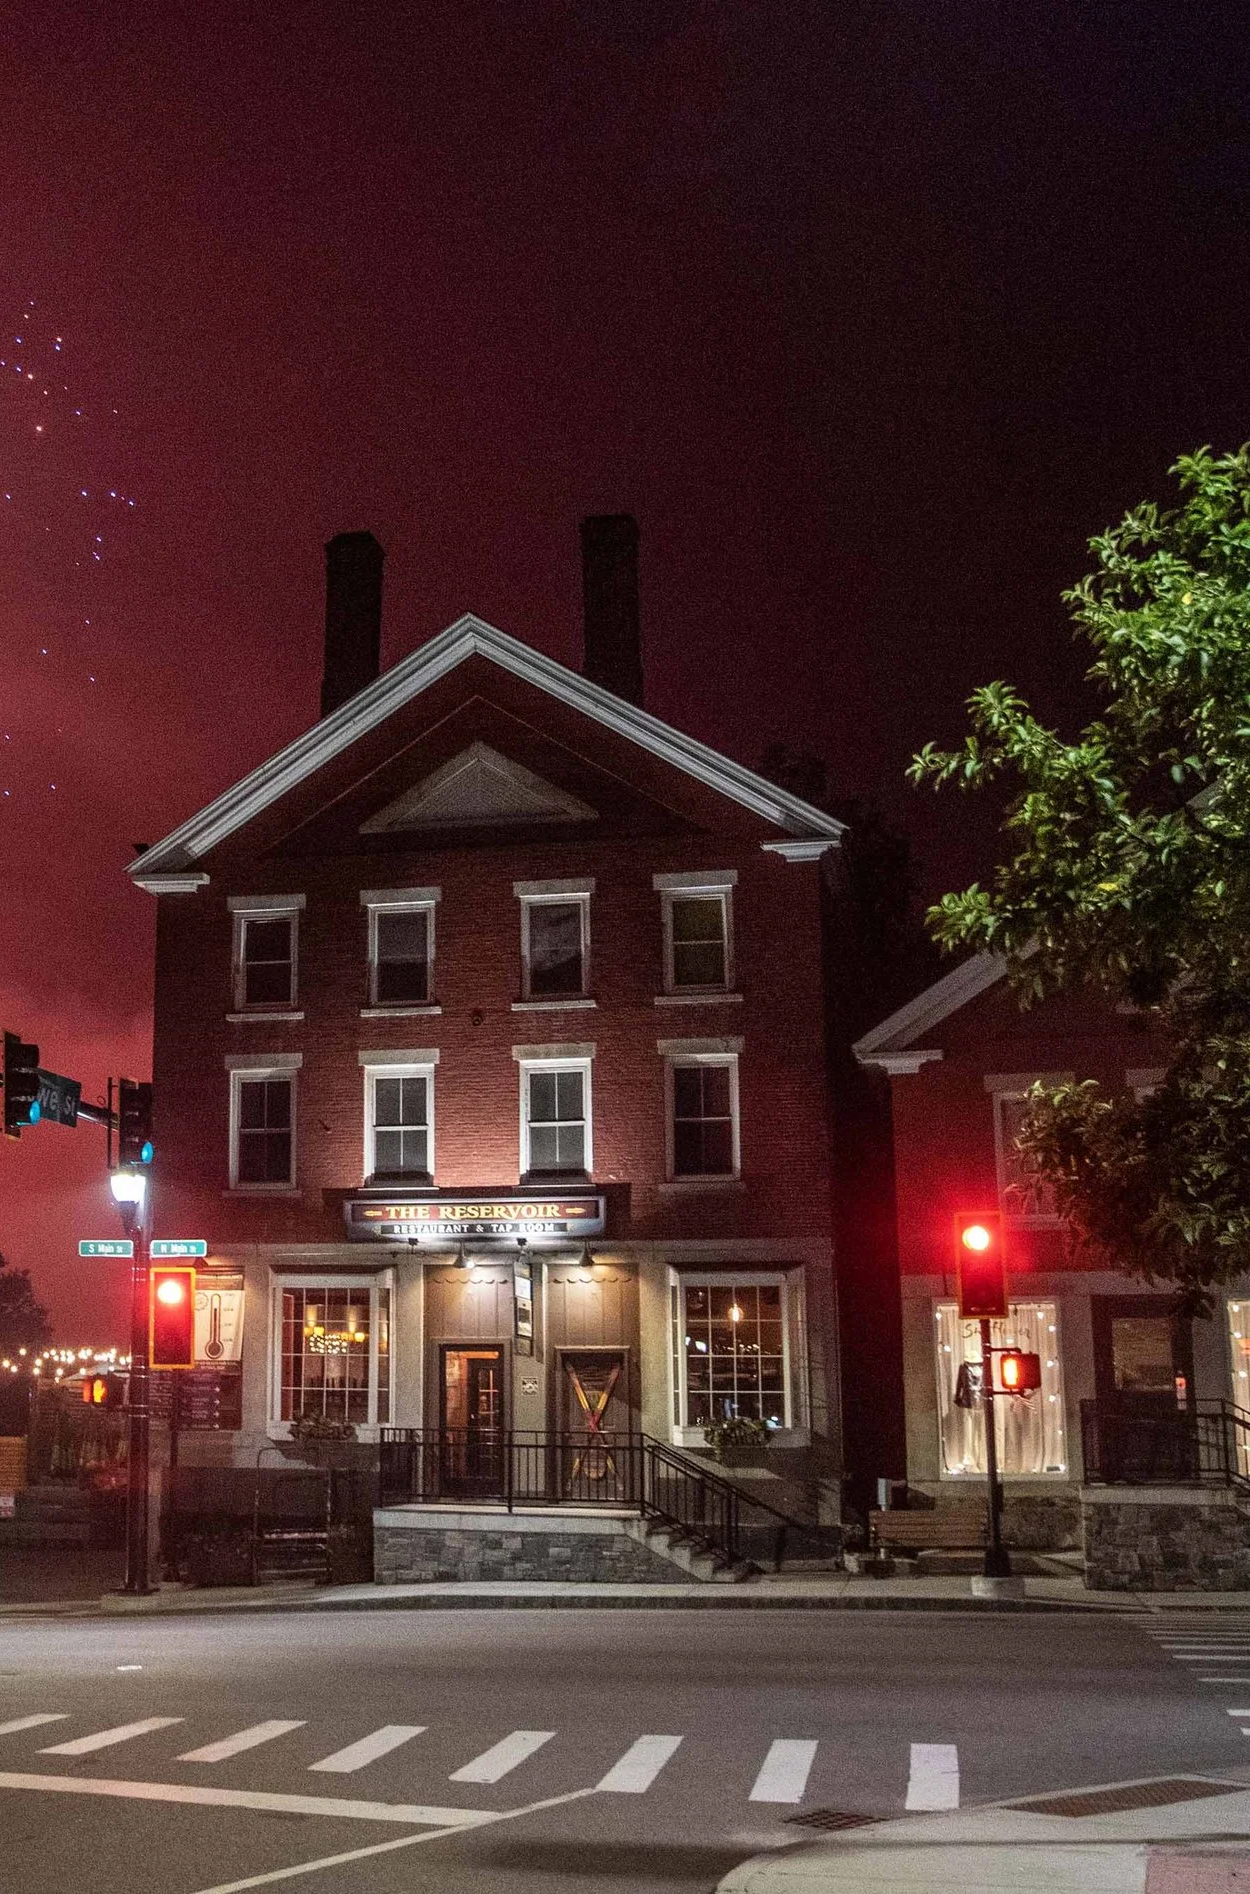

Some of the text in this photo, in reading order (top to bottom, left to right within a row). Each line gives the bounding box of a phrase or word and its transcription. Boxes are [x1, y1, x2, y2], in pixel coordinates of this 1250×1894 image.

[385, 1204, 562, 1220] THE RESERVOIR
[393, 1222, 555, 1234] RESTAURANT & TAP ROOM
[88, 1243, 95, 1254] S
[97, 1243, 115, 1254] Main
[160, 1243, 168, 1254] N
[170, 1243, 188, 1254] Main
